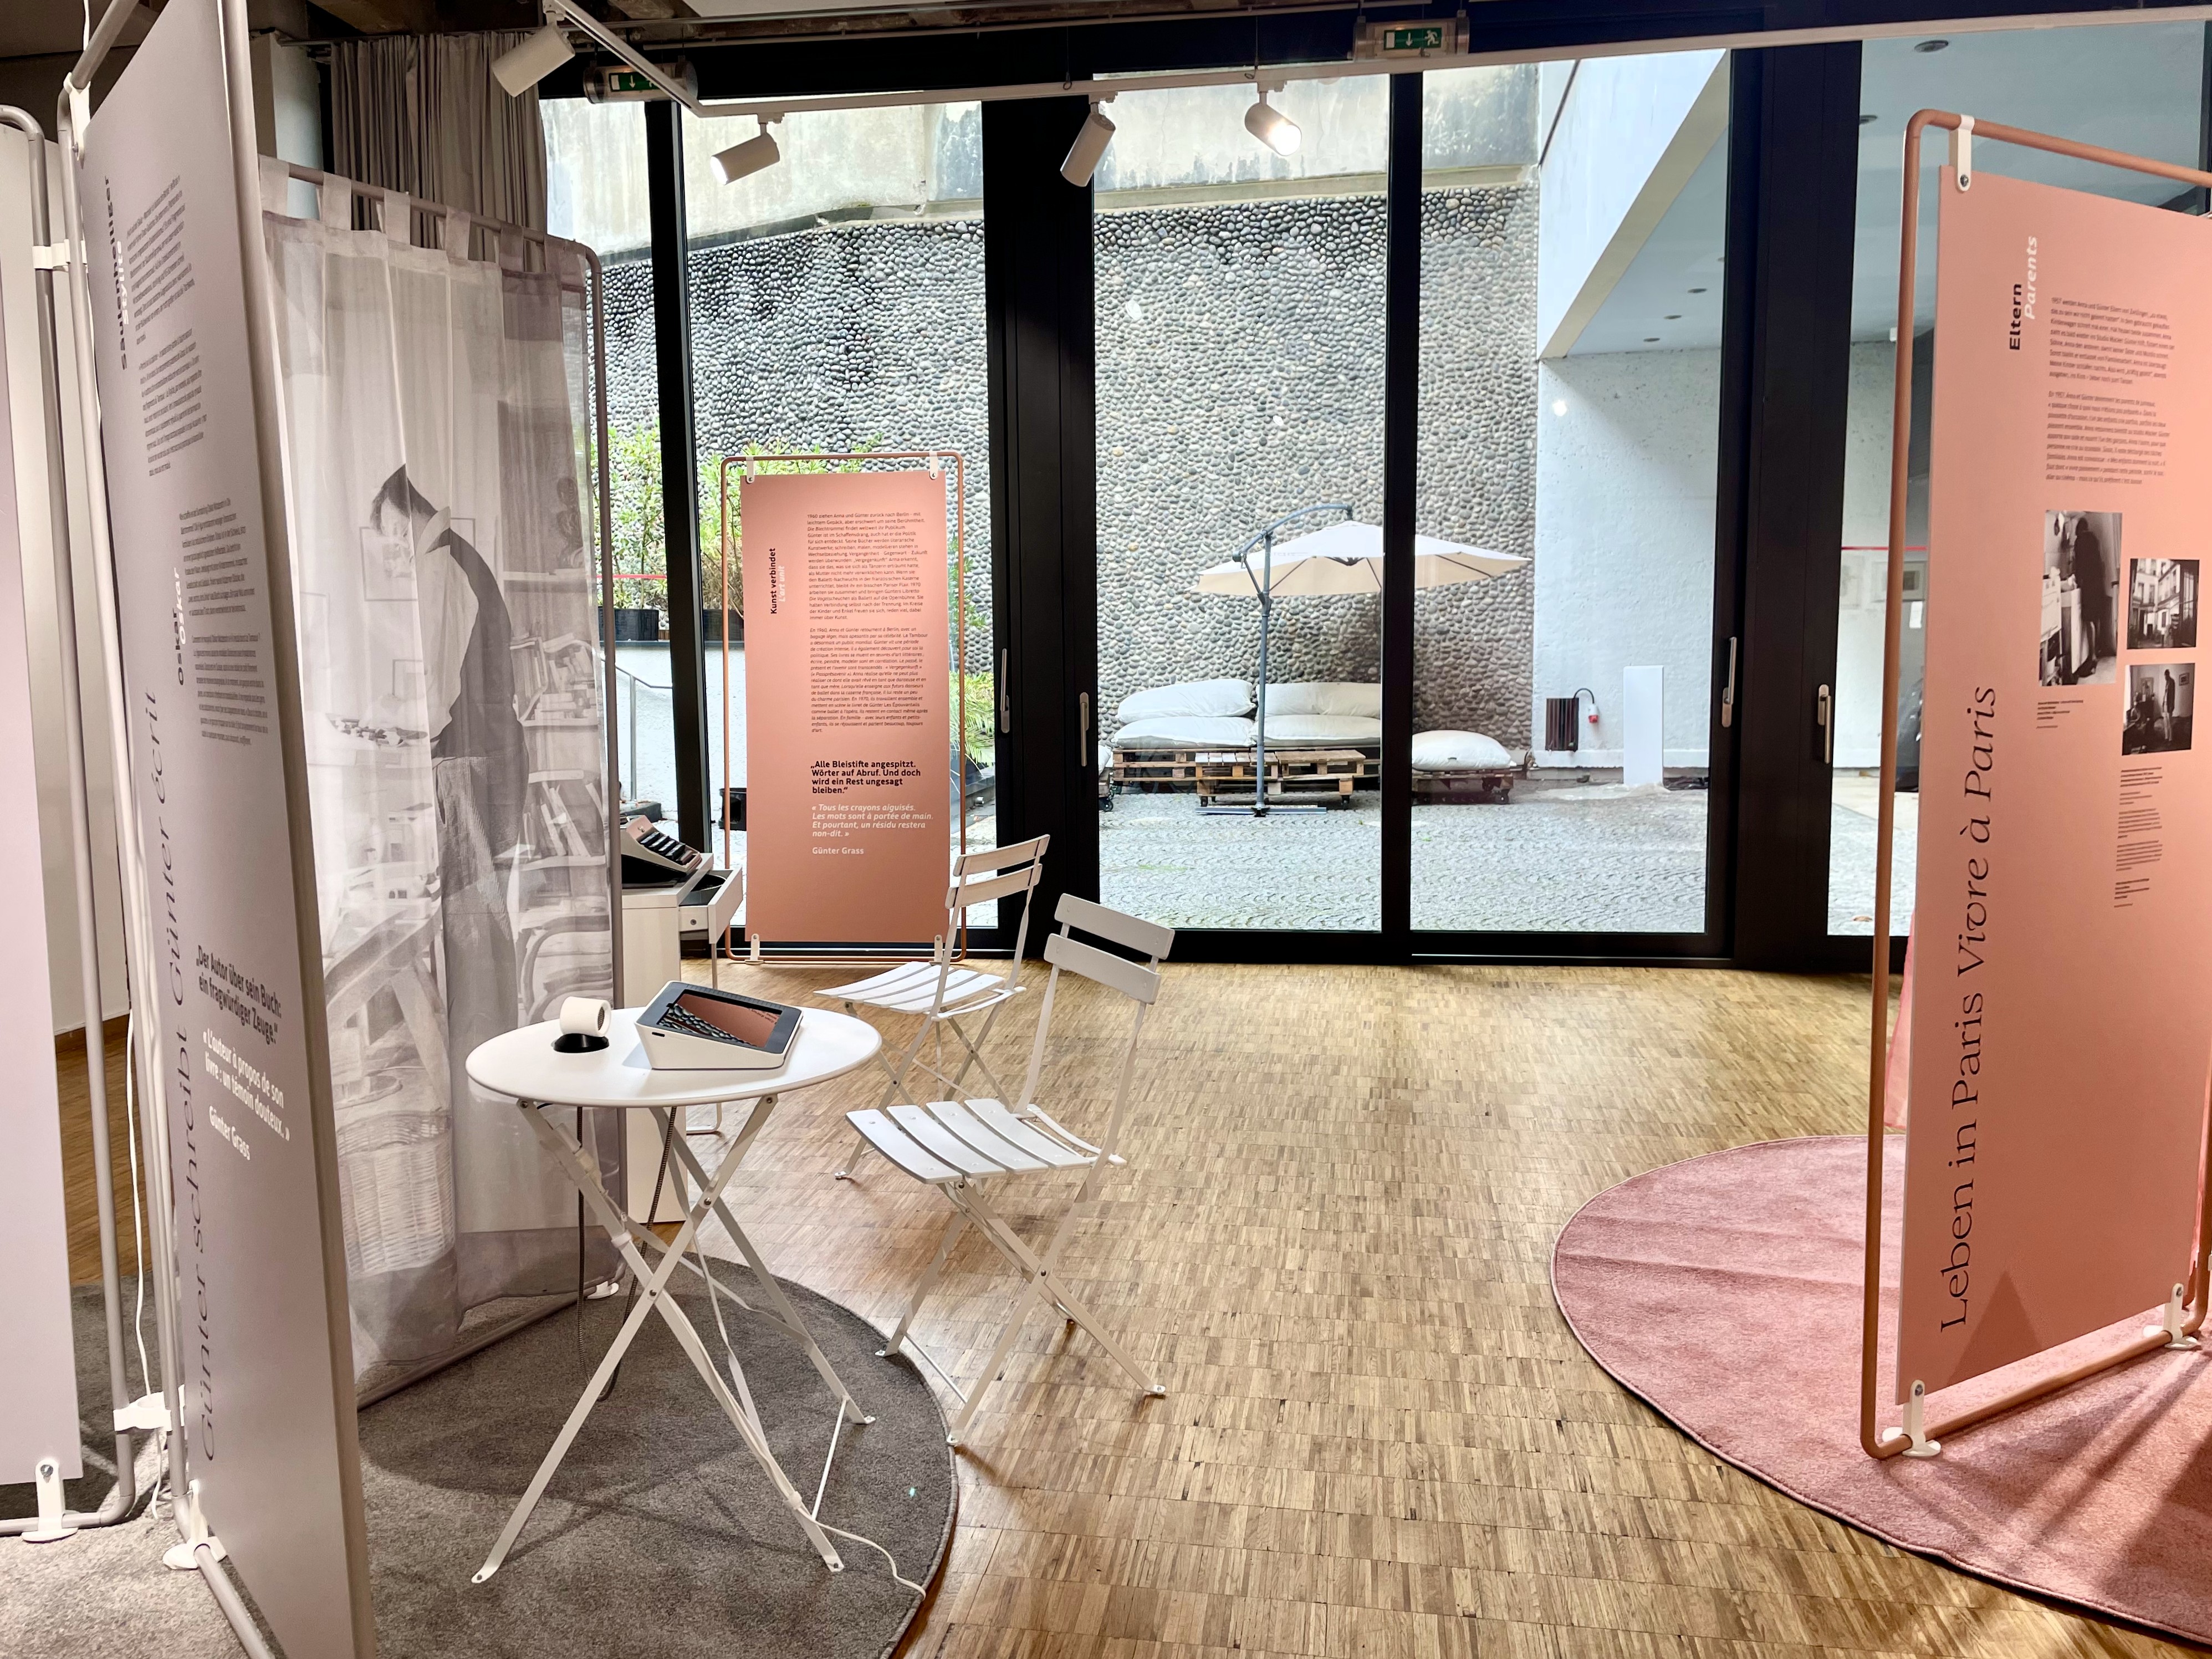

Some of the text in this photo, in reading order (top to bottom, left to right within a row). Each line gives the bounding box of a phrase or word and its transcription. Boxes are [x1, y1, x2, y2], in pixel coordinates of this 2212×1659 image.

[118, 241, 129, 325] Stylite
[2025, 236, 2037, 320] Parents
[2009, 283, 2022, 350] Eltern
[174, 567, 186, 644] Oskar
[173, 608, 184, 685] Oskar
[823, 821, 859, 830] pourtant,
[873, 812, 899, 821] portée
[882, 804, 916, 813] aiguisés.
[199, 972, 208, 995] ein
[210, 977, 251, 1026] fragwürdiger
[211, 952, 227, 981] Autor
[229, 963, 244, 992] über
[246, 978, 259, 1003] sein
[260, 983, 282, 1019] Buch:
[1940, 686, 1996, 1333] Leben in Paris Vivre à Paris
[145, 691, 214, 1462] Günter schreibt Günter écrit
[205, 1051, 218, 1080] livre
[223, 1071, 231, 1090] un
[232, 1074, 254, 1110] témoin
[255, 1094, 284, 1138] douteux.
[233, 1047, 237, 1070] à
[238, 1056, 260, 1089] propos
[262, 1072, 270, 1097] de
[272, 1085, 284, 1109] son
[210, 1105, 251, 1161] Günter Grass
